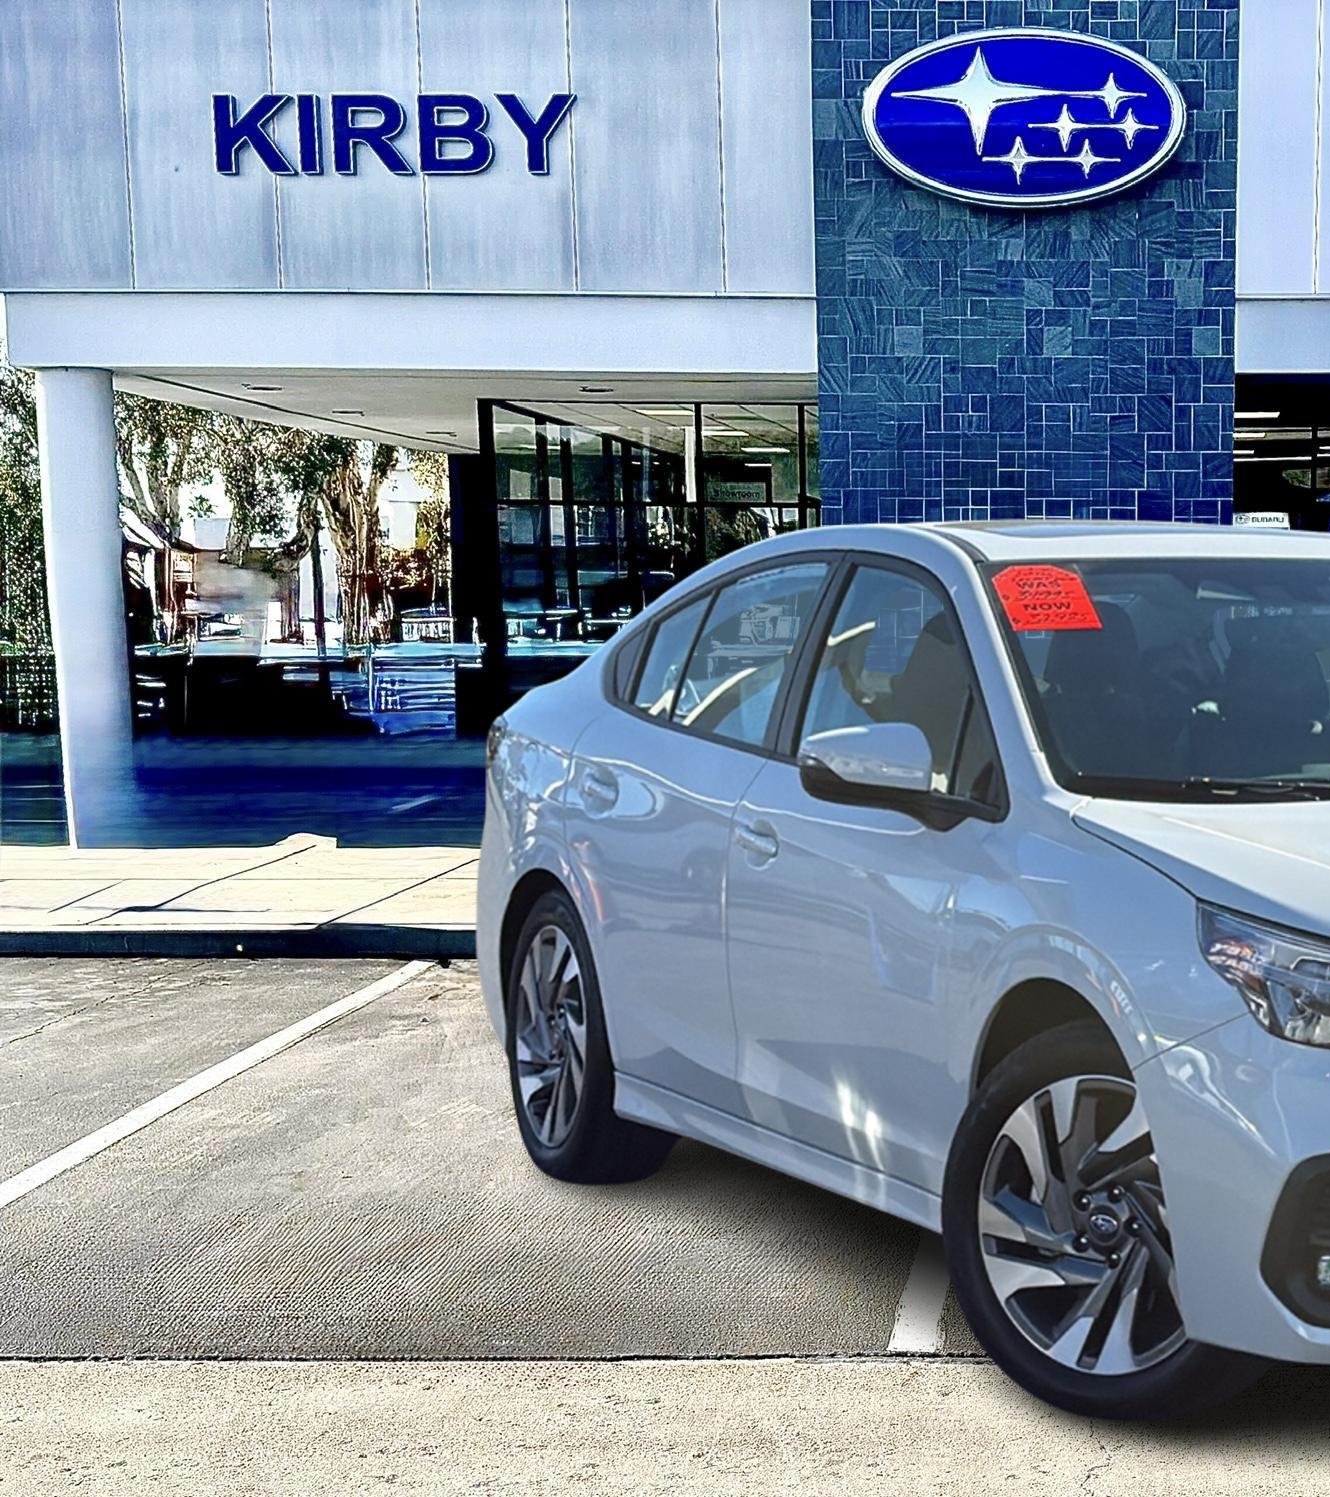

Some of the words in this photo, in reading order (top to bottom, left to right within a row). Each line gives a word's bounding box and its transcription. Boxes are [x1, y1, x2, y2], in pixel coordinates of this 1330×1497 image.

[212, 93, 577, 176] KIRBY
[1016, 580, 1061, 589] WAS
[1023, 602, 1071, 611] NOW
